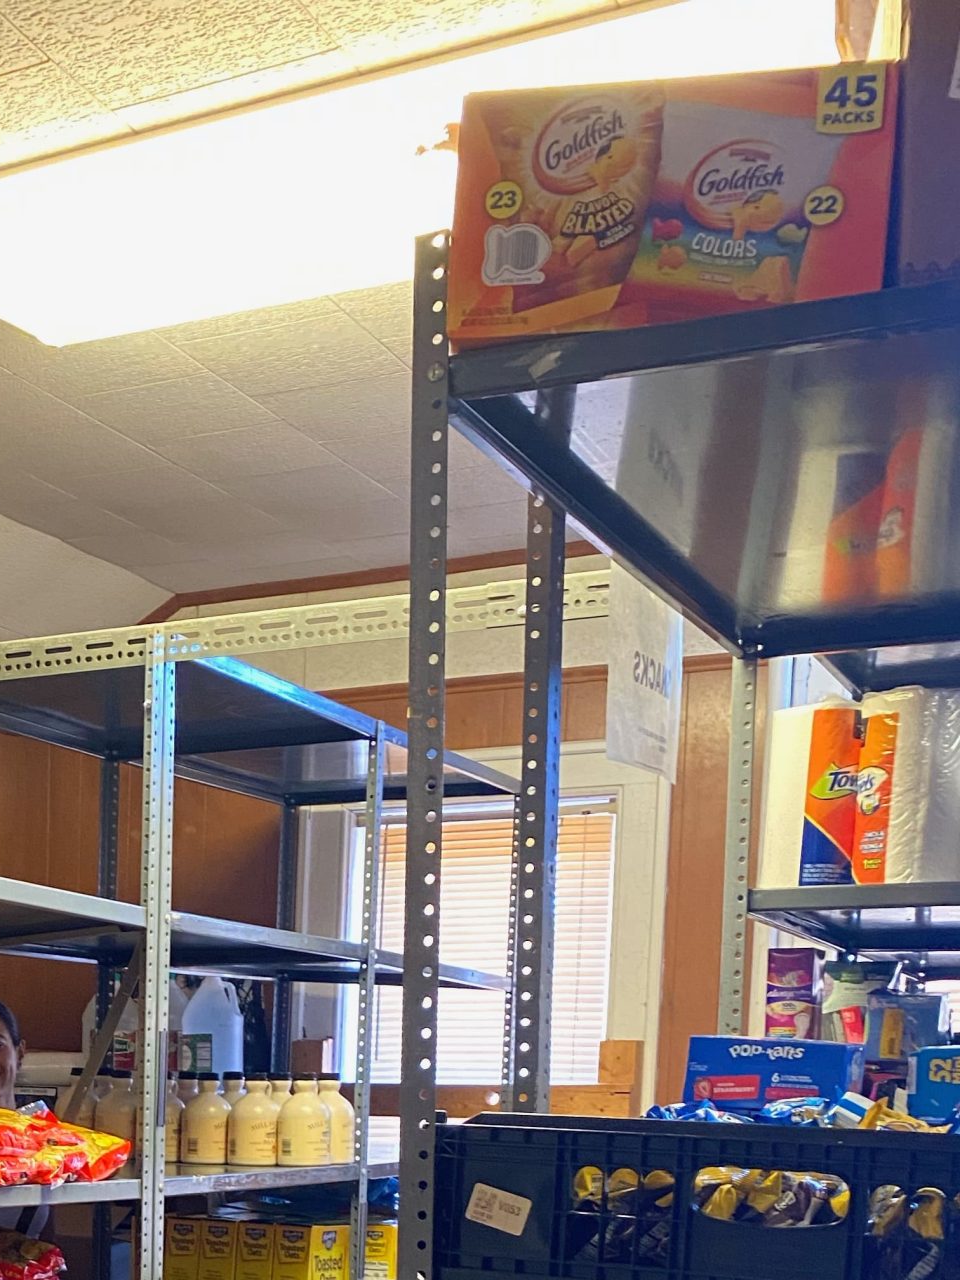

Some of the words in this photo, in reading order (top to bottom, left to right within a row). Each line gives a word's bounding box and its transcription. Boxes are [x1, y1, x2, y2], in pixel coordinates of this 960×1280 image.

[824, 75, 877, 108] 45
[822, 111, 875, 125] PACKS
[545, 109, 624, 170] Goldfish
[698, 164, 785, 196] Goldfish
[490, 190, 517, 210] 23
[573, 192, 618, 214] FLAVOR
[809, 195, 838, 215] 22
[562, 199, 634, 234] BLASTED
[692, 232, 757, 258] COLORS
[771, 1073, 780, 1083] 6
[314, 1253, 343, 1272] Toasted
